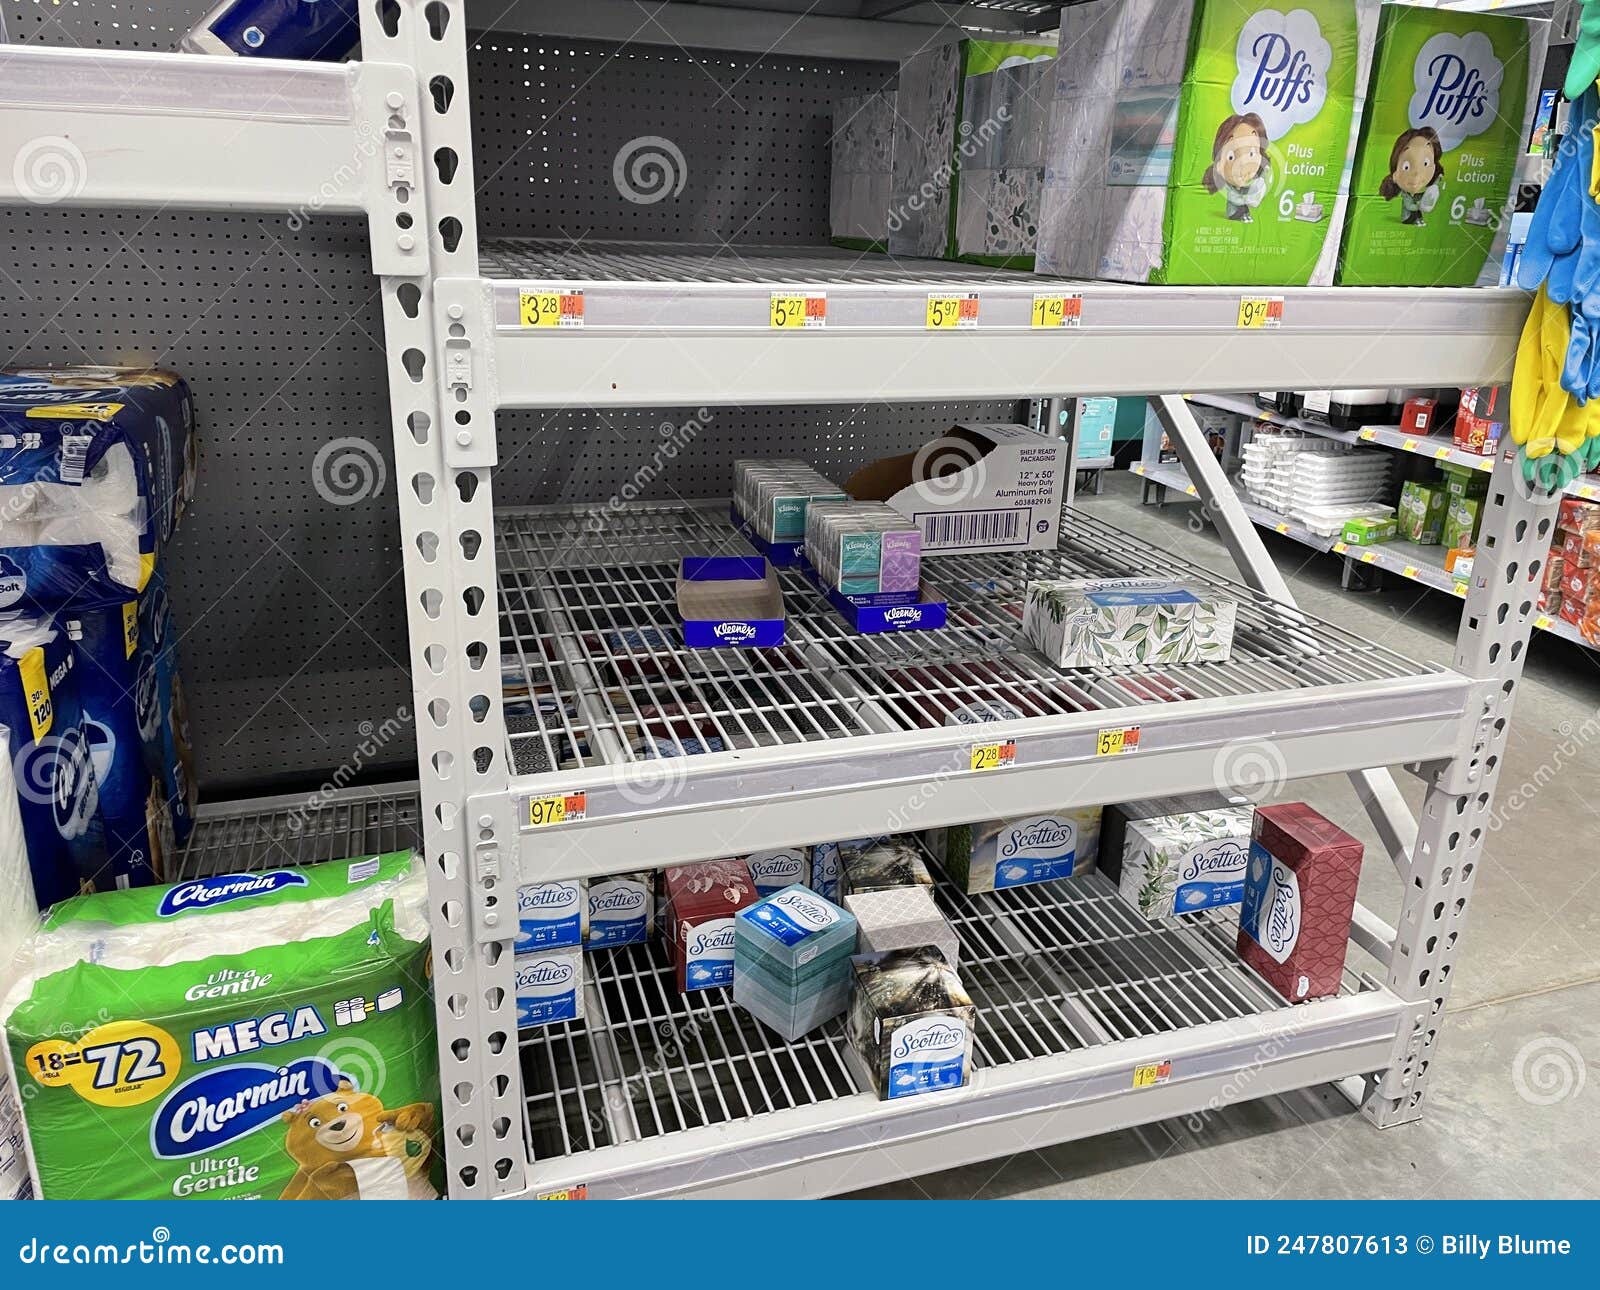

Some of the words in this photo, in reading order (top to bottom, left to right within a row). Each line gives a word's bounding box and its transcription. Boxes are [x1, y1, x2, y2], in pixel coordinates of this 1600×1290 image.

[1244, 33, 1315, 112] Puffs
[1419, 53, 1488, 126] Puffs
[1288, 144, 1314, 159] Plus
[1460, 153, 1484, 166] Plus
[1284, 161, 1325, 178] Lotion
[1457, 170, 1496, 184] Lotion
[1279, 190, 1294, 216] 6
[1451, 195, 1466, 220] 6
[996, 489, 1037, 497] Aluminum
[1039, 487, 1052, 495] Foil
[884, 606, 922, 623] Kleenex
[713, 622, 757, 638] Kleenex
[34, 698, 51, 725] 120
[1002, 827, 1067, 857] Scotties
[752, 856, 799, 881] Scotties
[1183, 850, 1248, 880] Scotties
[172, 873, 277, 905] Charmin
[777, 894, 831, 926] Scotties
[1273, 866, 1294, 951] Scotties
[689, 931, 736, 956] Scotti
[184, 971, 274, 1002] Gentle
[207, 968, 257, 985] Ultra
[516, 966, 569, 990] cotties
[193, 1006, 326, 1062] MEGA
[894, 1031, 960, 1059] Scotties
[170, 1067, 311, 1144] Charmin
[190, 1156, 239, 1175] Ultra
[172, 1165, 260, 1197] Gentle
